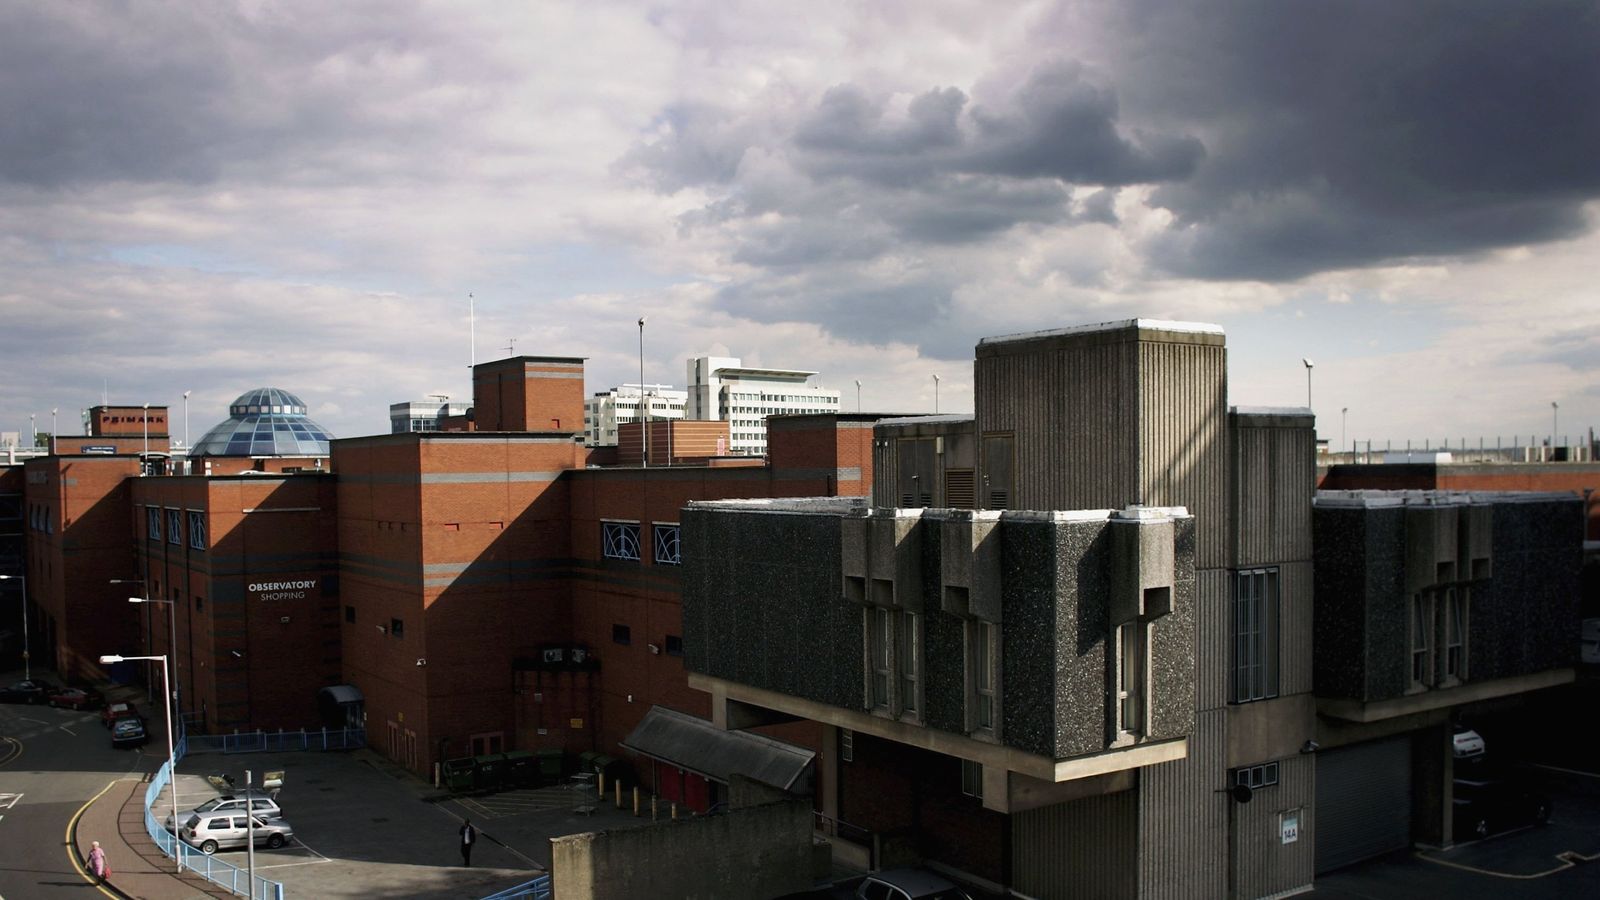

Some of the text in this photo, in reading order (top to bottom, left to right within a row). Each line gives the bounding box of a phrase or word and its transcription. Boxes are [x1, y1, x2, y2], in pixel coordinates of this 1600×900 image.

[248, 580, 316, 592] OBSERVATORY
[260, 591, 305, 601] SHOPPING
[1284, 828, 1297, 841] 14A
